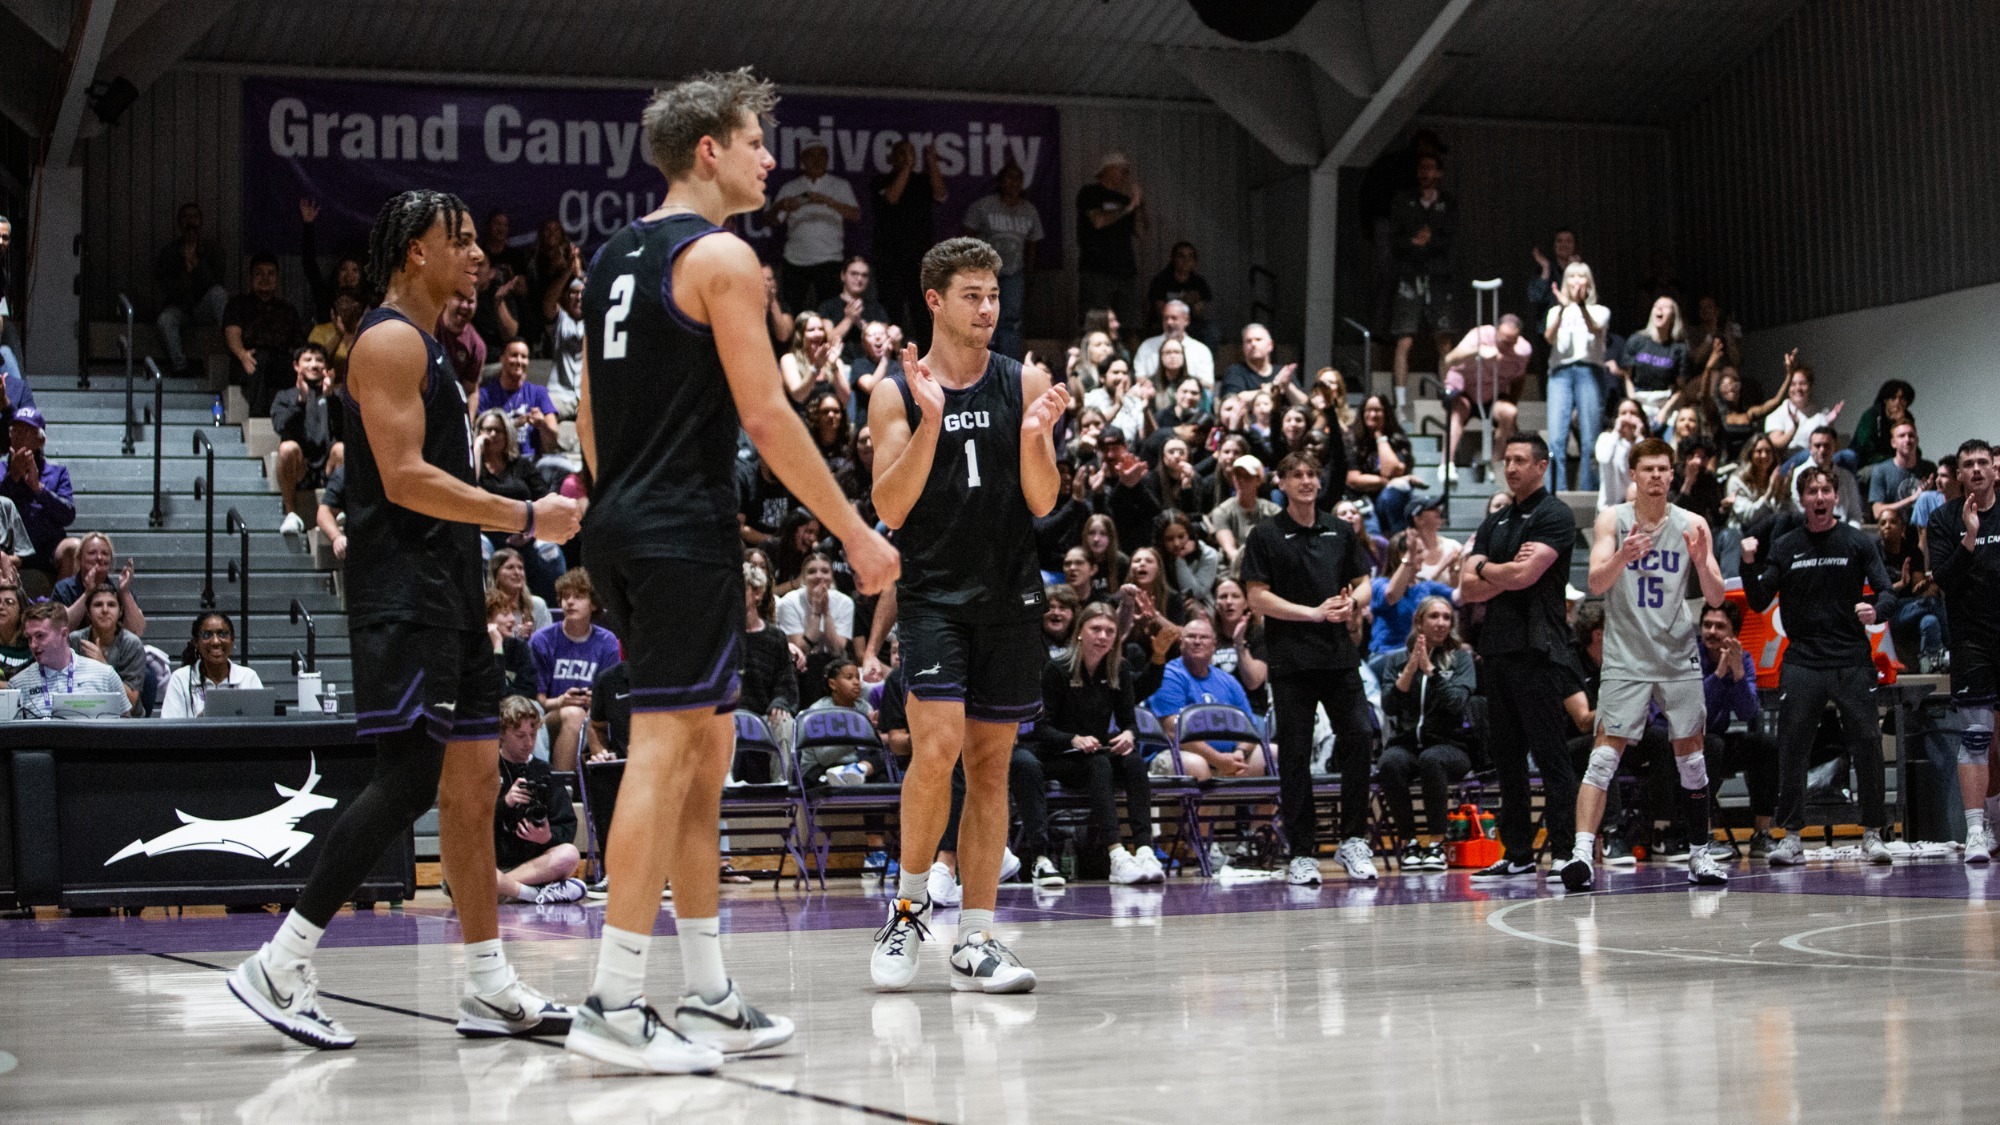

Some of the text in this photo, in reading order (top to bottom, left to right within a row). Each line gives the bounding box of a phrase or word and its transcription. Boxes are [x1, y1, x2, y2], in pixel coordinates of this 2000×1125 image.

[269, 97, 1042, 190] Grand Cany niversity
[603, 273, 635, 360] 2
[944, 411, 990, 432] GCU
[964, 438, 981, 488] 1
[1637, 576, 1664, 608] 15
[553, 658, 597, 681] GCU
[805, 712, 867, 738] GCU
[1187, 710, 1246, 733] GCU
